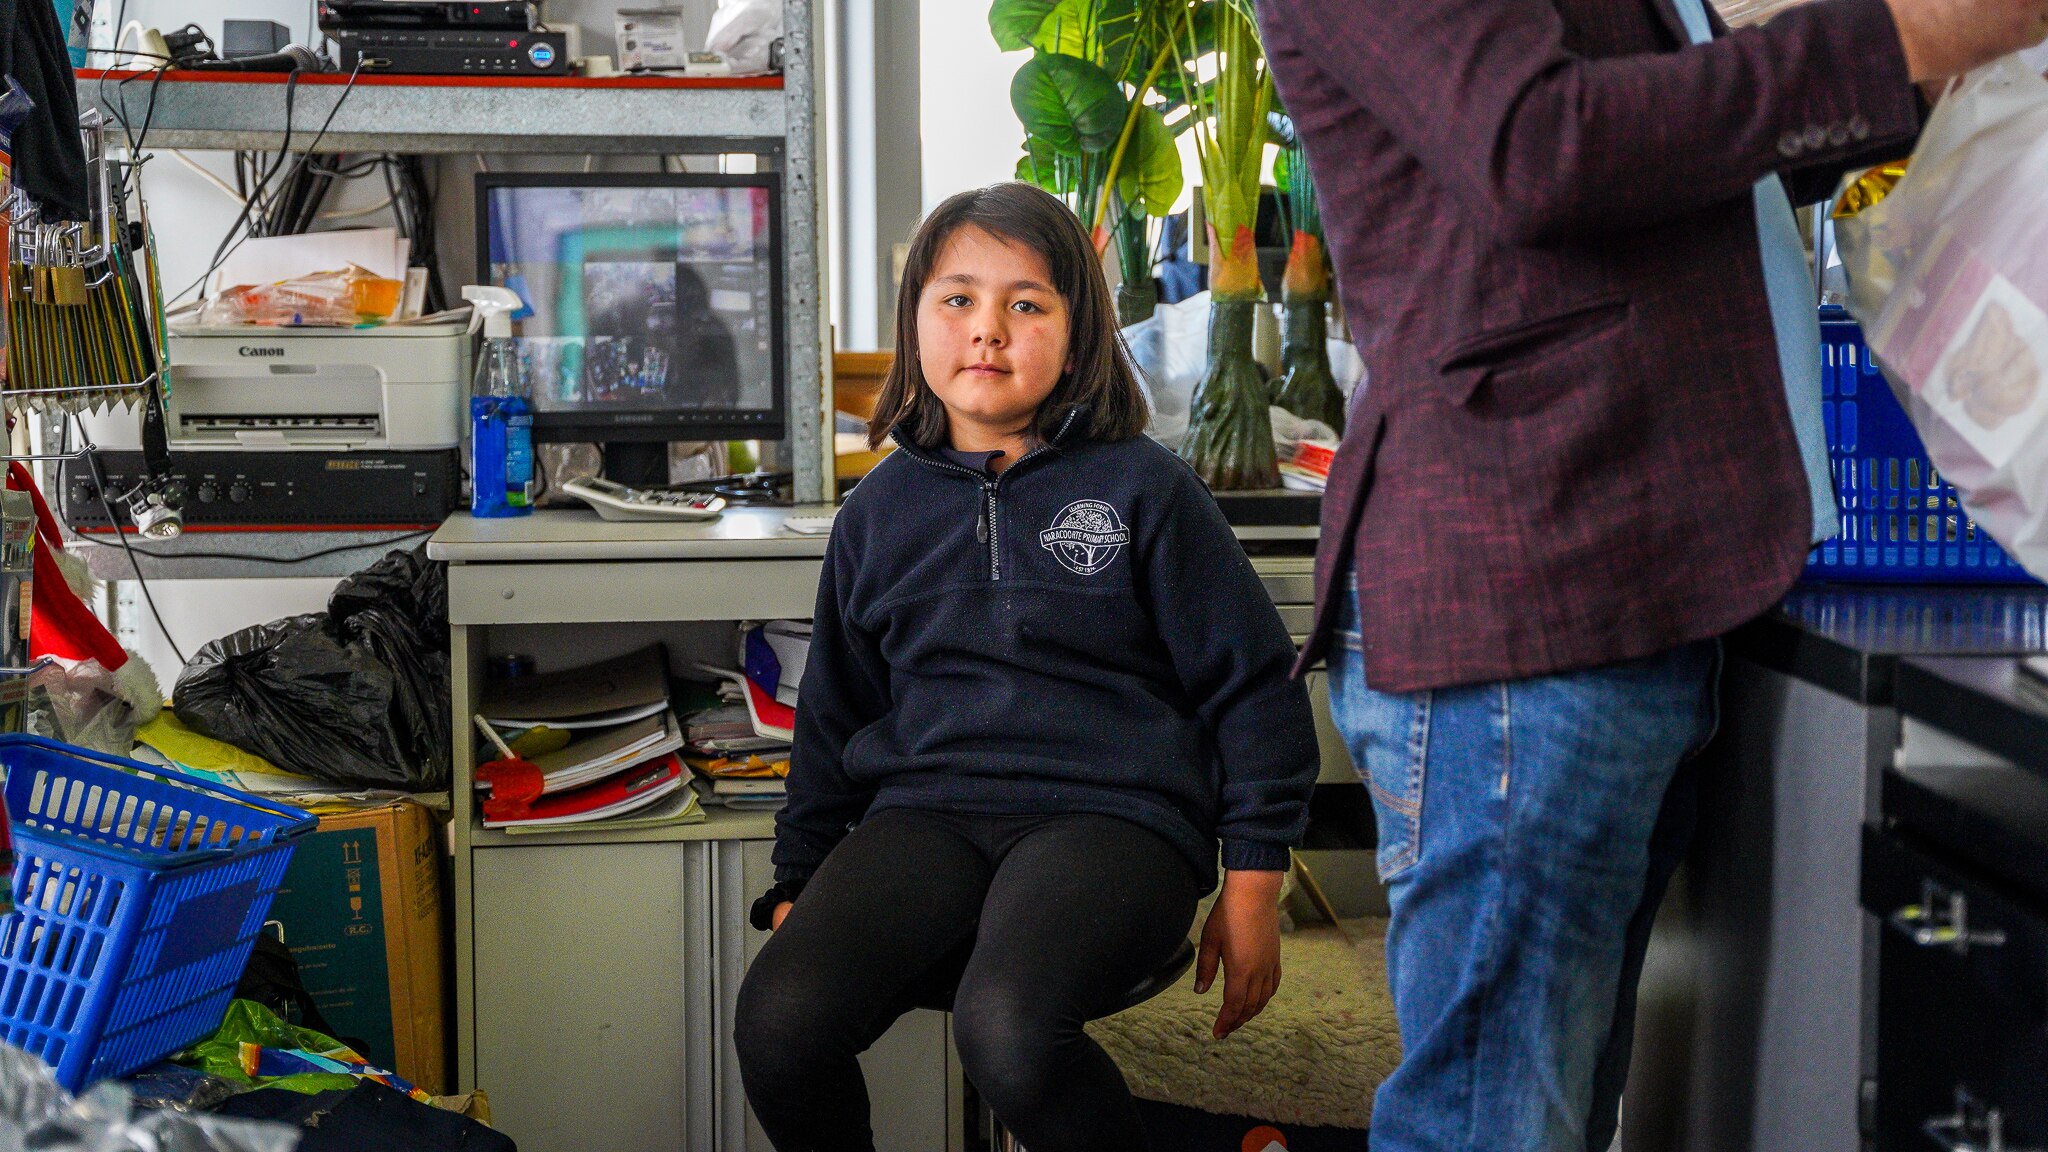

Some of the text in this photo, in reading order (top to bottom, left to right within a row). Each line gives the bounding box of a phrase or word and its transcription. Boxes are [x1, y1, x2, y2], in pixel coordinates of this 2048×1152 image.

[238, 346, 284, 357] Canon
[1043, 530, 1082, 542] NARACOORTE
[1103, 532, 1128, 544] SCHOOL
